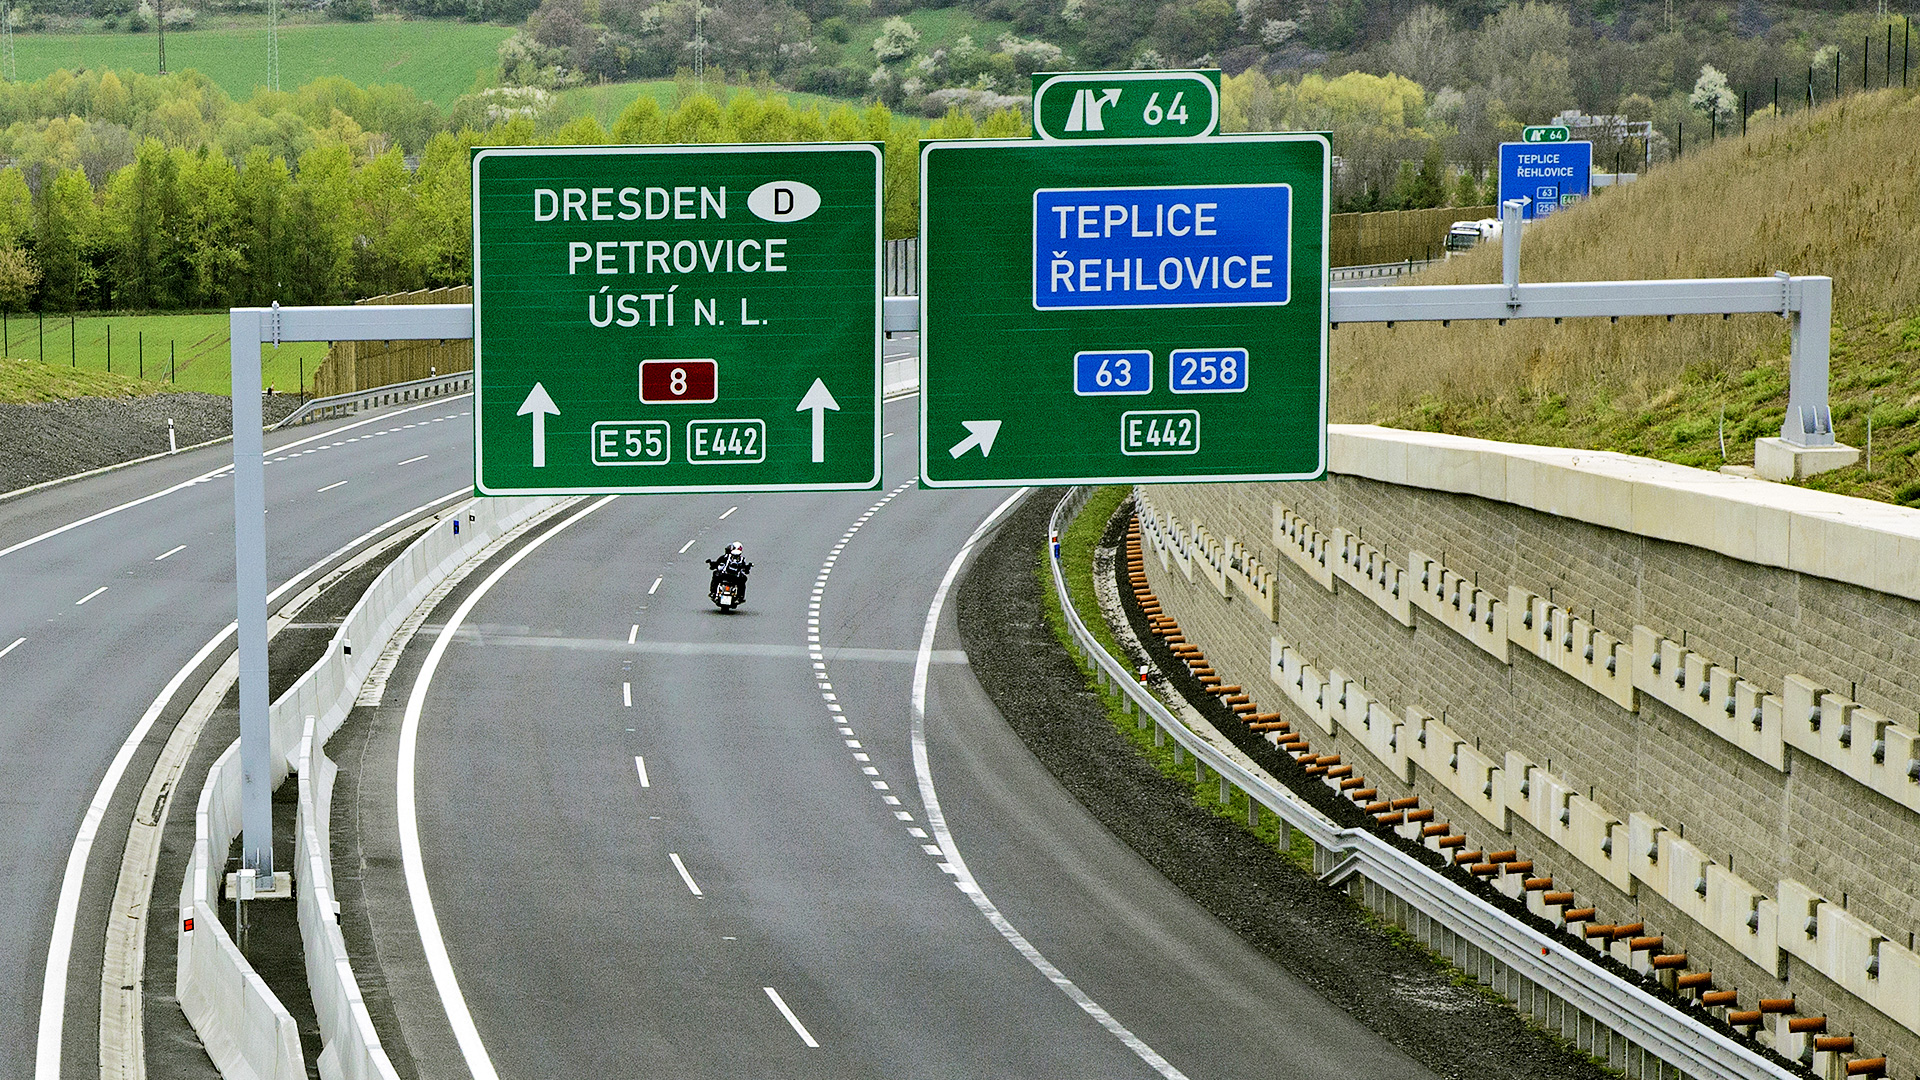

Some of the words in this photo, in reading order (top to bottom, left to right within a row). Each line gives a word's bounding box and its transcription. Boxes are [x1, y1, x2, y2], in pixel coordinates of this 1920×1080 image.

[1142, 92, 1189, 125] 64
[1550, 131, 1562, 140] 64
[1517, 166, 1574, 177] ŘEHLOVICE
[1518, 154, 1560, 164] TEPLICE
[534, 186, 727, 221] DRESDEN
[774, 188, 794, 215] D
[1542, 189, 1552, 197] 63
[1052, 202, 1218, 239] TEPLICE
[569, 239, 787, 274] PETROVICE
[1050, 250, 1274, 292] ŘEHLOVICE
[588, 285, 679, 327] ÚSTÍ
[694, 298, 725, 326] N.
[741, 298, 768, 325] L.
[669, 368, 687, 396] 8
[1095, 359, 1132, 387] 63
[1180, 357, 1238, 385] 258
[695, 427, 757, 456] E442
[1129, 418, 1192, 447] E442
